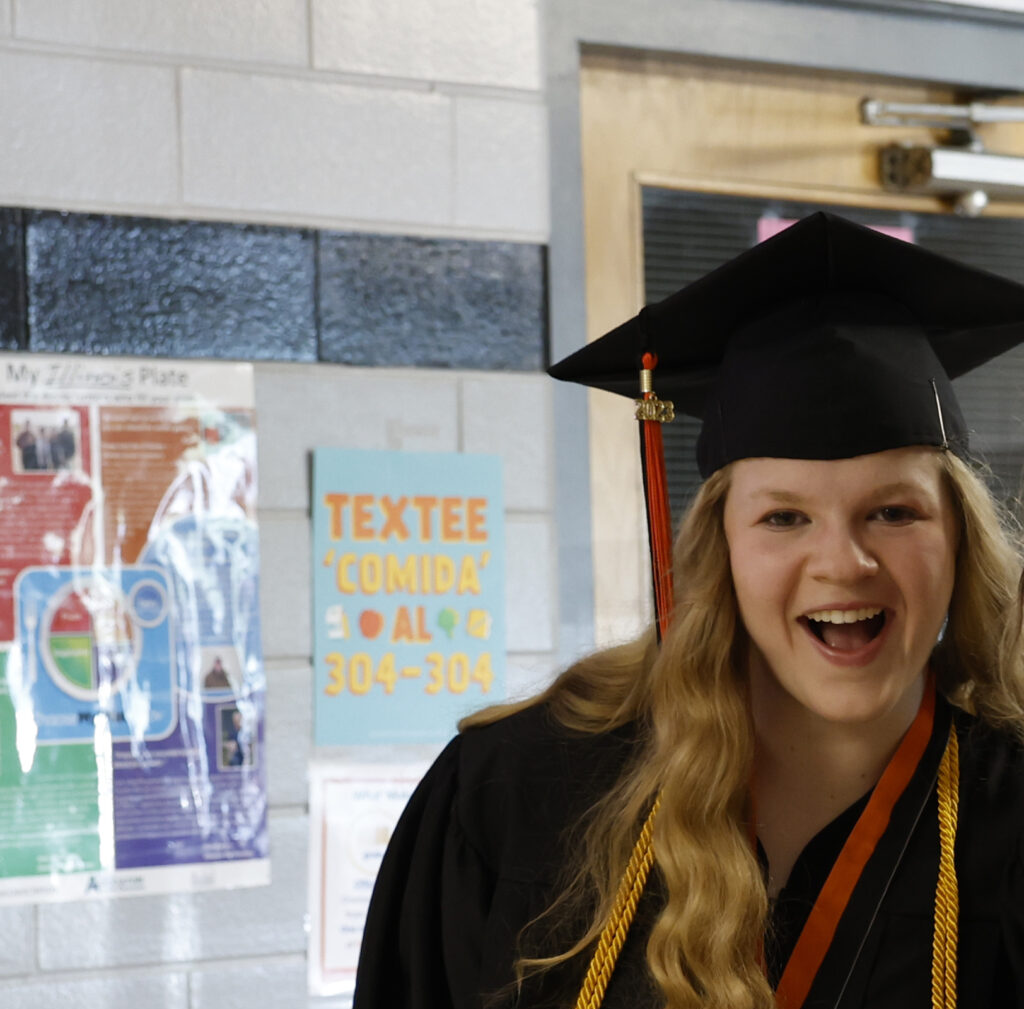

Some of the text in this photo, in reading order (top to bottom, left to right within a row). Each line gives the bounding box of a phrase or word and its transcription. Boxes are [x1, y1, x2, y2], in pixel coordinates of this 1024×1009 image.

[7, 364, 42, 387] My
[139, 367, 189, 388] Plate
[635, 398, 675, 423] 2023
[323, 492, 489, 543] TEXTEE
[390, 604, 433, 643] AL
[323, 652, 495, 696] 304-304
